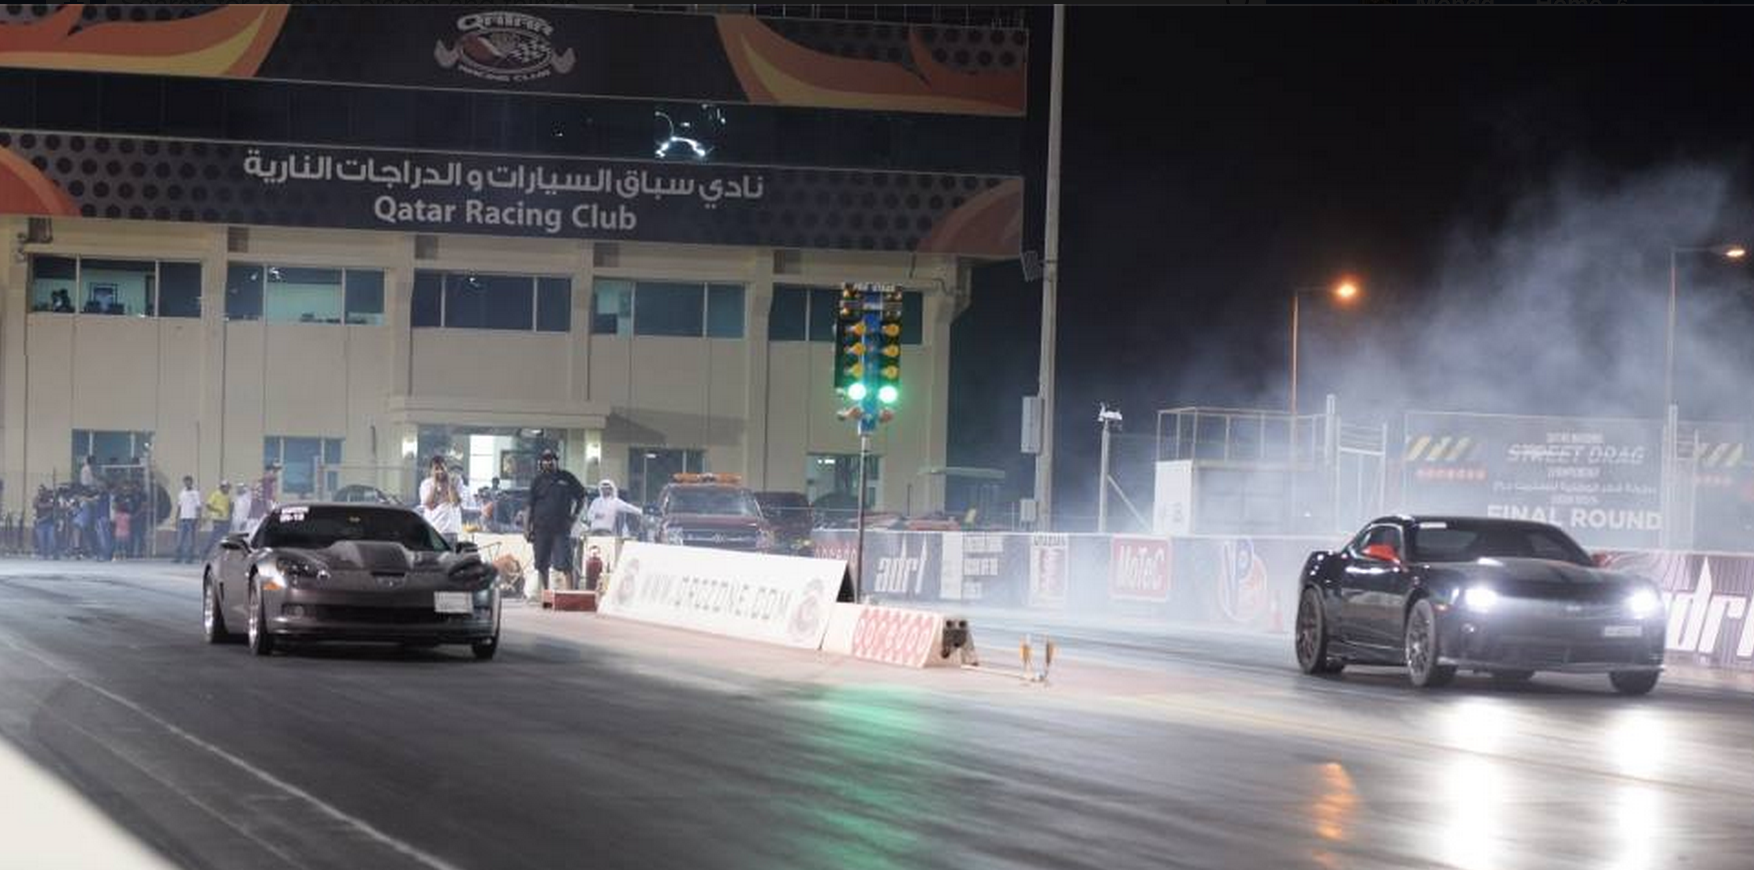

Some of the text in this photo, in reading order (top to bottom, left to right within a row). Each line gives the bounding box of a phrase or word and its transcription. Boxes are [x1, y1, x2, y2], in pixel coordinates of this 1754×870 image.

[243, 149, 333, 184] النارية
[335, 157, 463, 189] الدراجات
[486, 164, 612, 196] السيارات
[615, 170, 695, 200] سباق
[699, 174, 764, 209] نادي
[374, 195, 638, 234] Qatar Racing Club
[1507, 443, 1645, 465] STREET DRAG
[1487, 504, 1663, 531] FINAL ROUND
